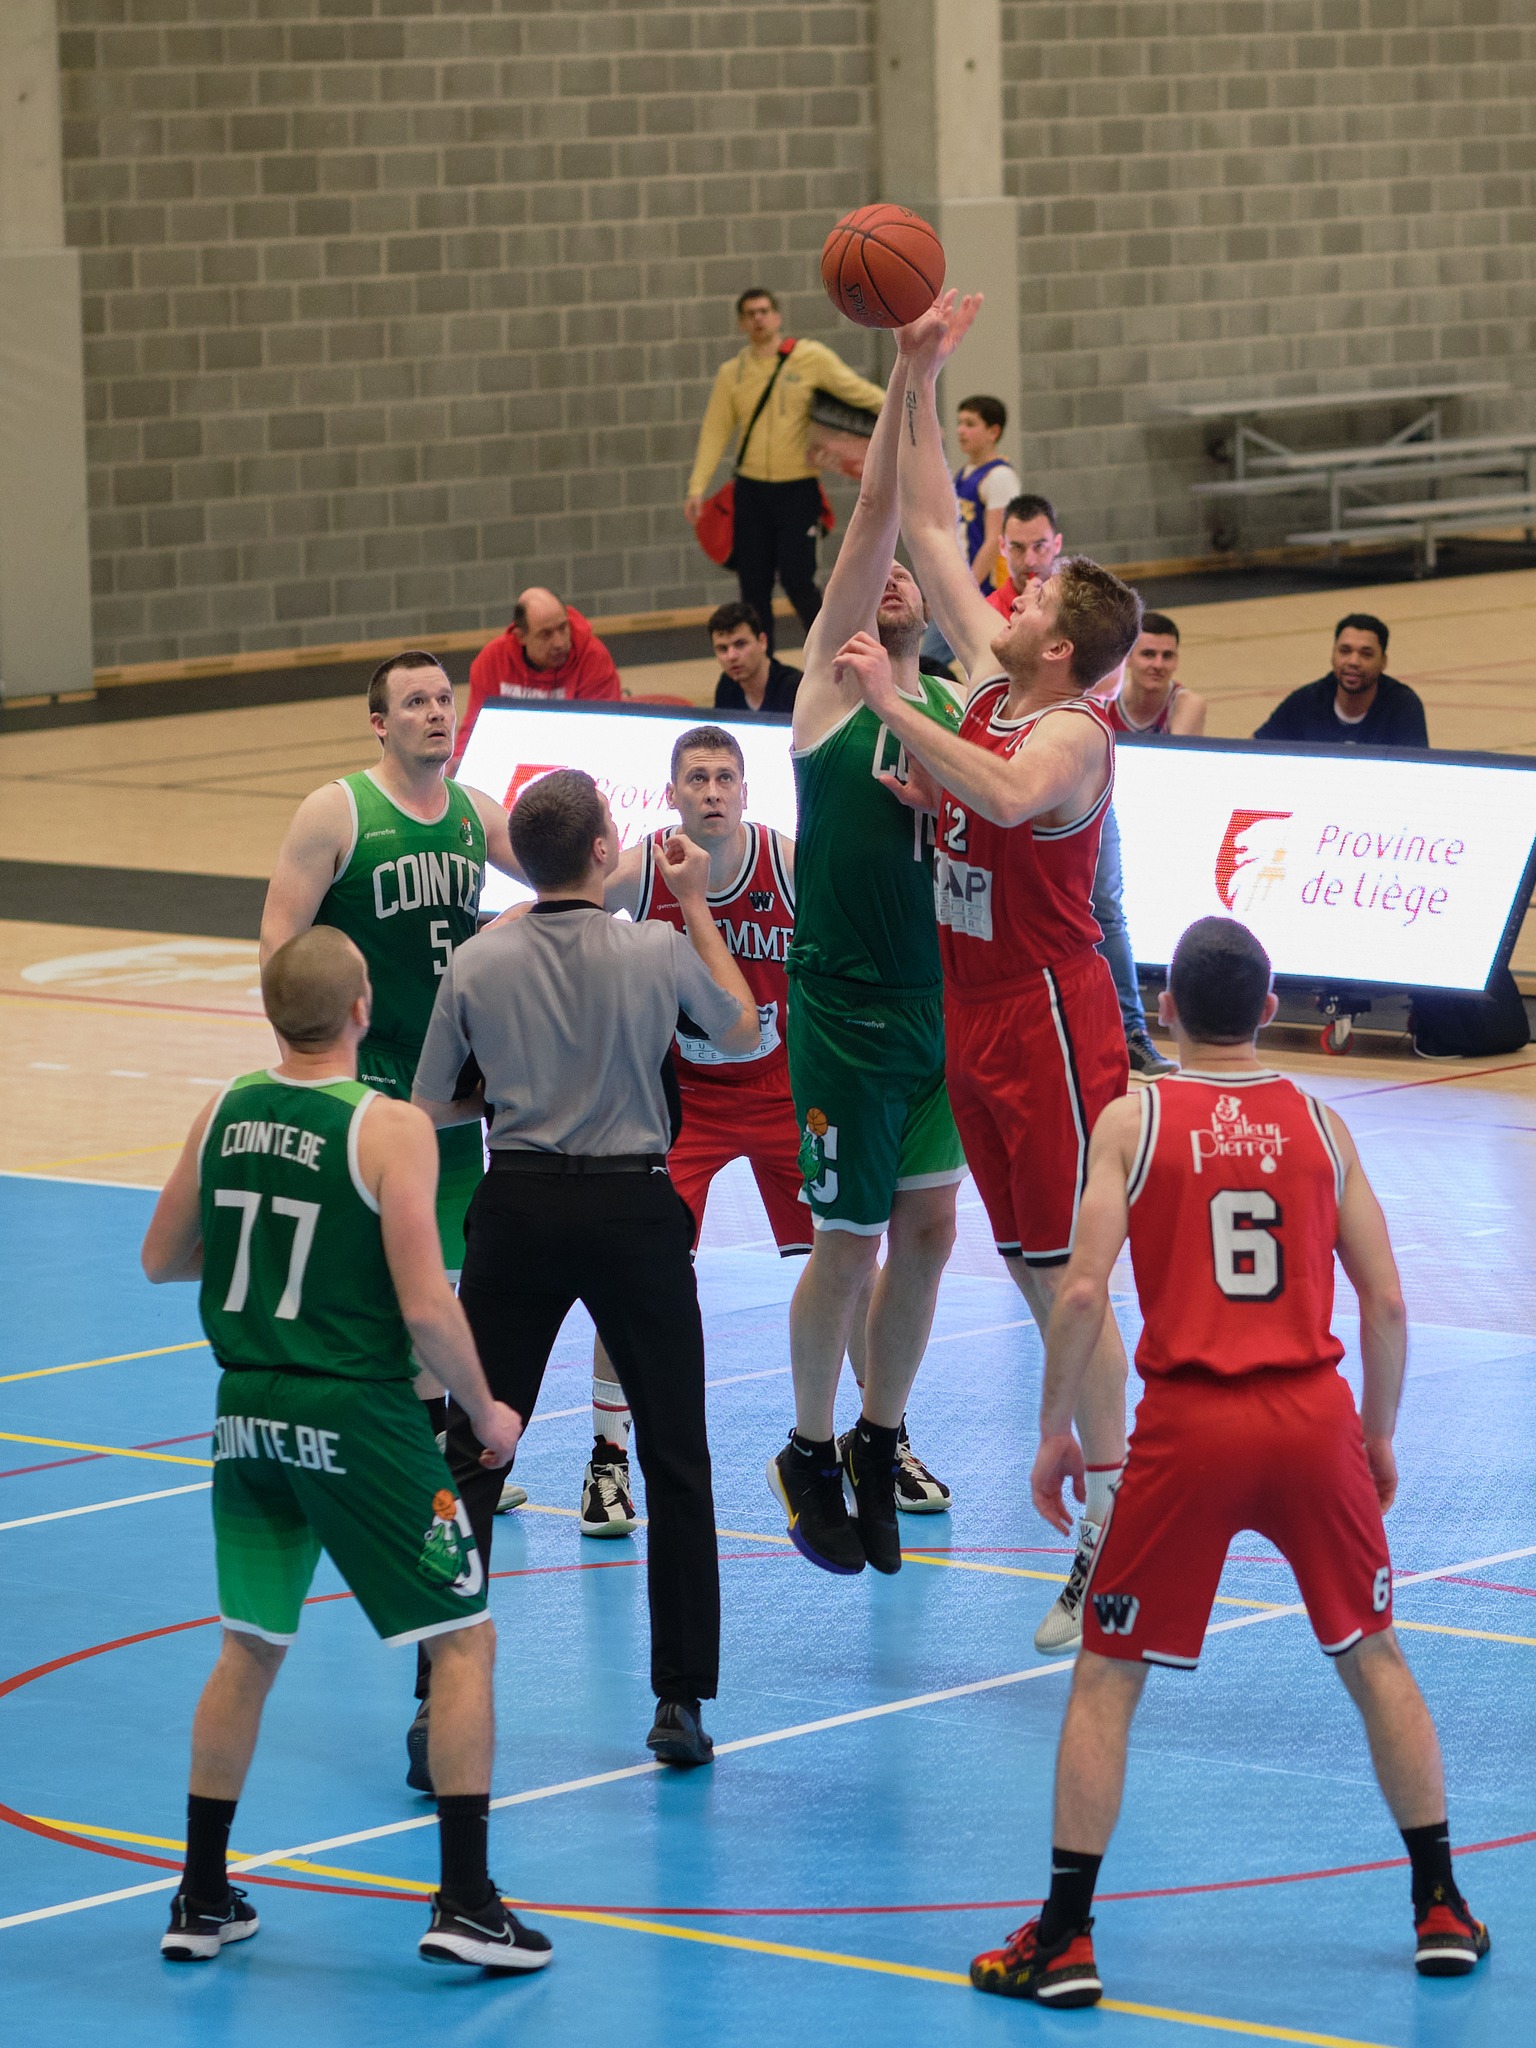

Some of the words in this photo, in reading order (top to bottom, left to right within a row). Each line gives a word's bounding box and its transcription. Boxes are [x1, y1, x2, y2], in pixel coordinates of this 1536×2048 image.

[944, 800, 967, 852] 12
[1316, 824, 1465, 865] Province
[372, 851, 481, 920] COINTE
[1301, 870, 1344, 905] de
[430, 920, 452, 975] 5
[221, 1121, 327, 1172] COINTE.BE
[214, 1188, 322, 1320] 77
[1209, 1188, 1284, 1302] 6
[213, 1415, 347, 1475] OINTE.BE
[1372, 1565, 1390, 1613] 6
